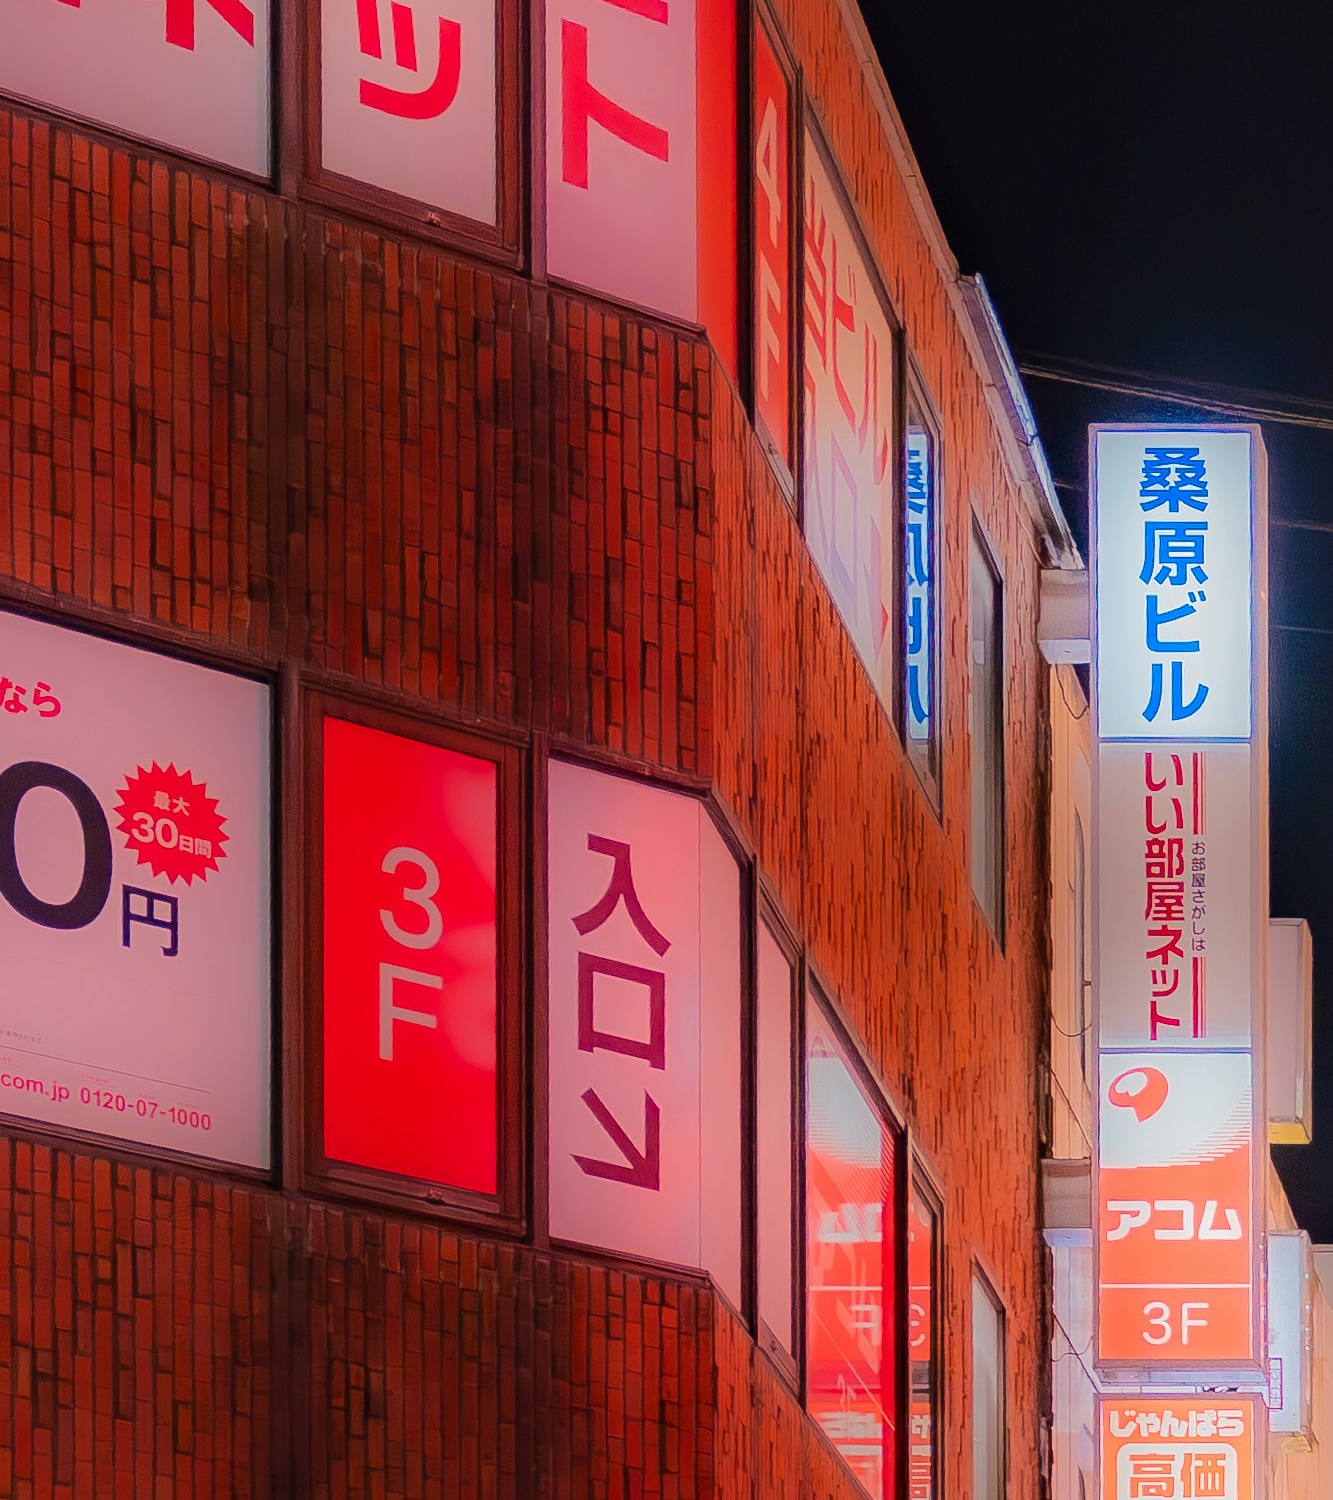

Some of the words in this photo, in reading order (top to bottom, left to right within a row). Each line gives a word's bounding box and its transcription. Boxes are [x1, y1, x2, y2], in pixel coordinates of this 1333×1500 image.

[756, 97, 782, 401] 4F
[1138, 446, 1211, 724] 桑原ビル
[0, 676, 62, 718] なら
[153, 789, 190, 818] 最大
[1143, 752, 1185, 1042] いい部屋ネット
[1190, 840, 1208, 952] お部屋さがしは
[379, 847, 444, 1062] 3F
[571, 832, 672, 1072] 入口
[81, 1085, 211, 1132] 0120-07-1000
[1105, 1199, 1244, 1242] アコム
[1141, 1300, 1211, 1346] 3F
[1108, 1409, 1245, 1439] じゃんぱら
[1129, 1452, 1226, 1499] 高価
